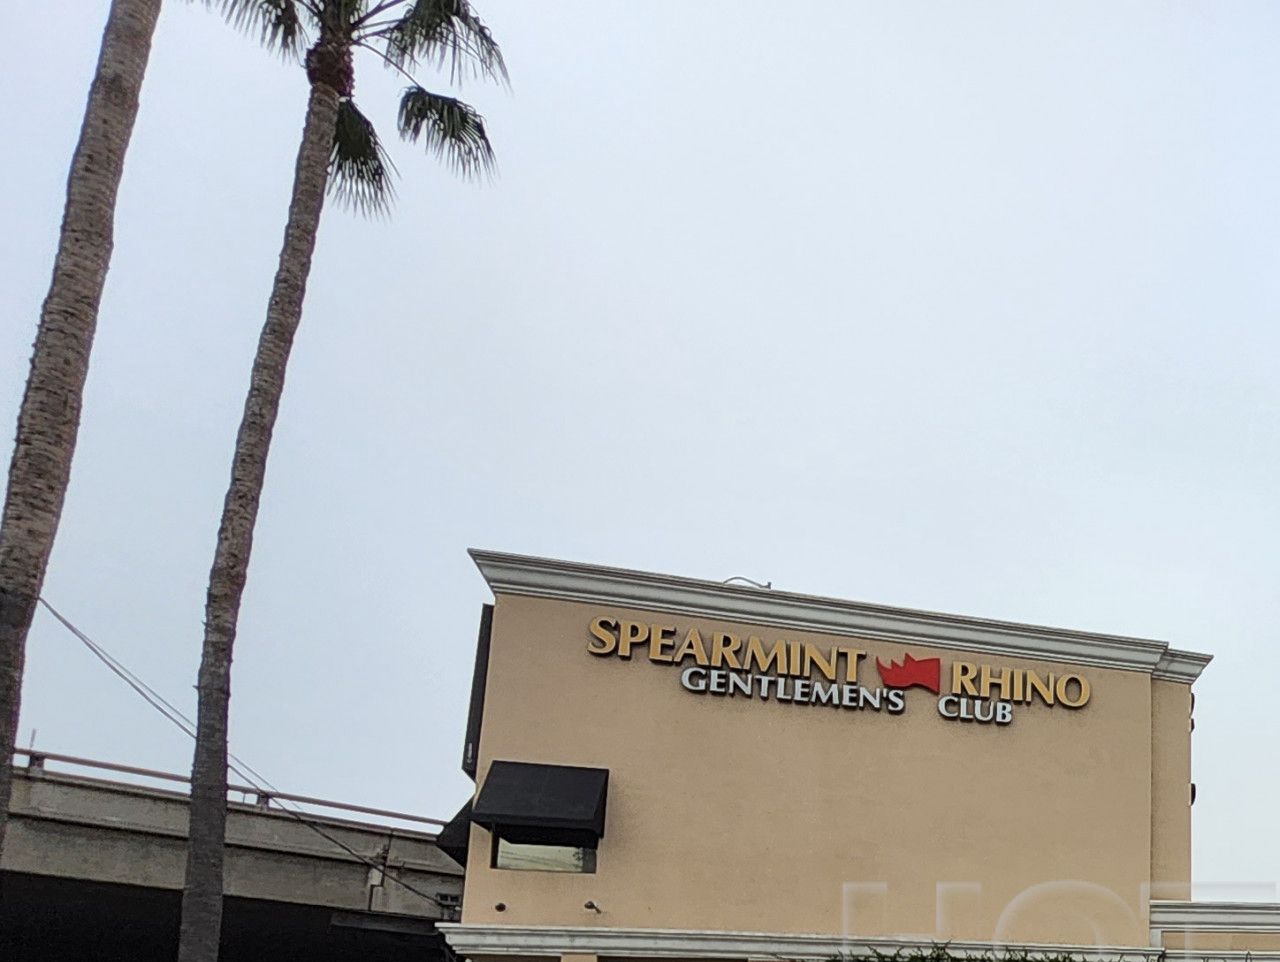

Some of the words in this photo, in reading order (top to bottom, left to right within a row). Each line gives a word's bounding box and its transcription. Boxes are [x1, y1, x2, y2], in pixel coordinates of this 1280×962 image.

[587, 616, 867, 683] SPEARMINT
[951, 660, 1092, 709] RHINO
[681, 668, 905, 712] GENTLEMEN'S
[937, 696, 1013, 724] CLUB
